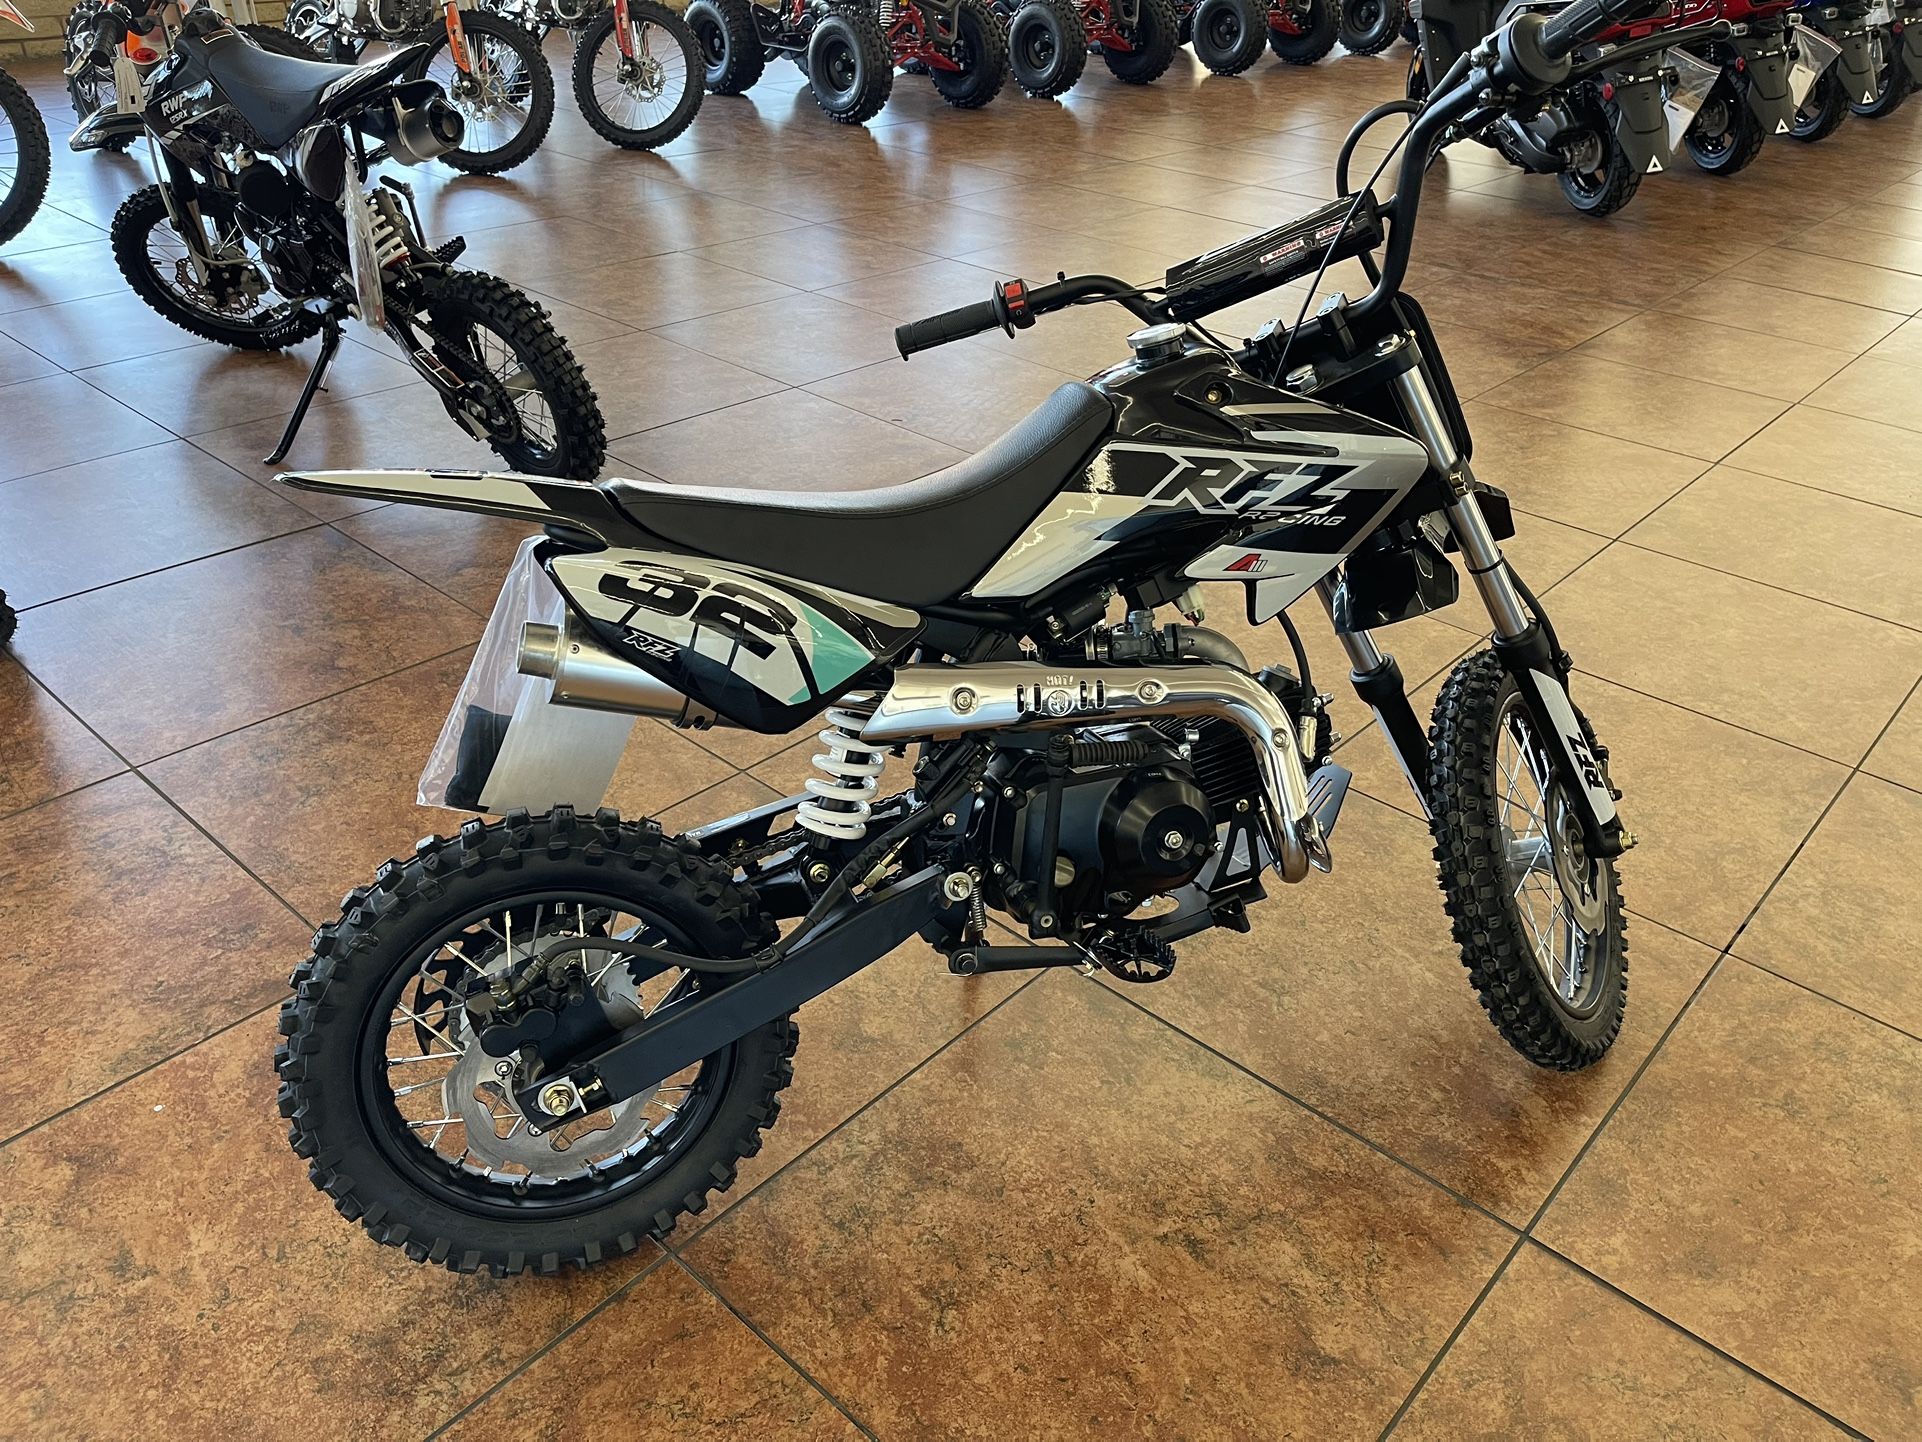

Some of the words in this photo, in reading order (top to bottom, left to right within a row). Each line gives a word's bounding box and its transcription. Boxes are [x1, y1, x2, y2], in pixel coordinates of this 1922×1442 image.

[1144, 452, 1377, 515] RFZ
[622, 629, 681, 658] RFZ
[1565, 731, 1605, 791] RFZ
